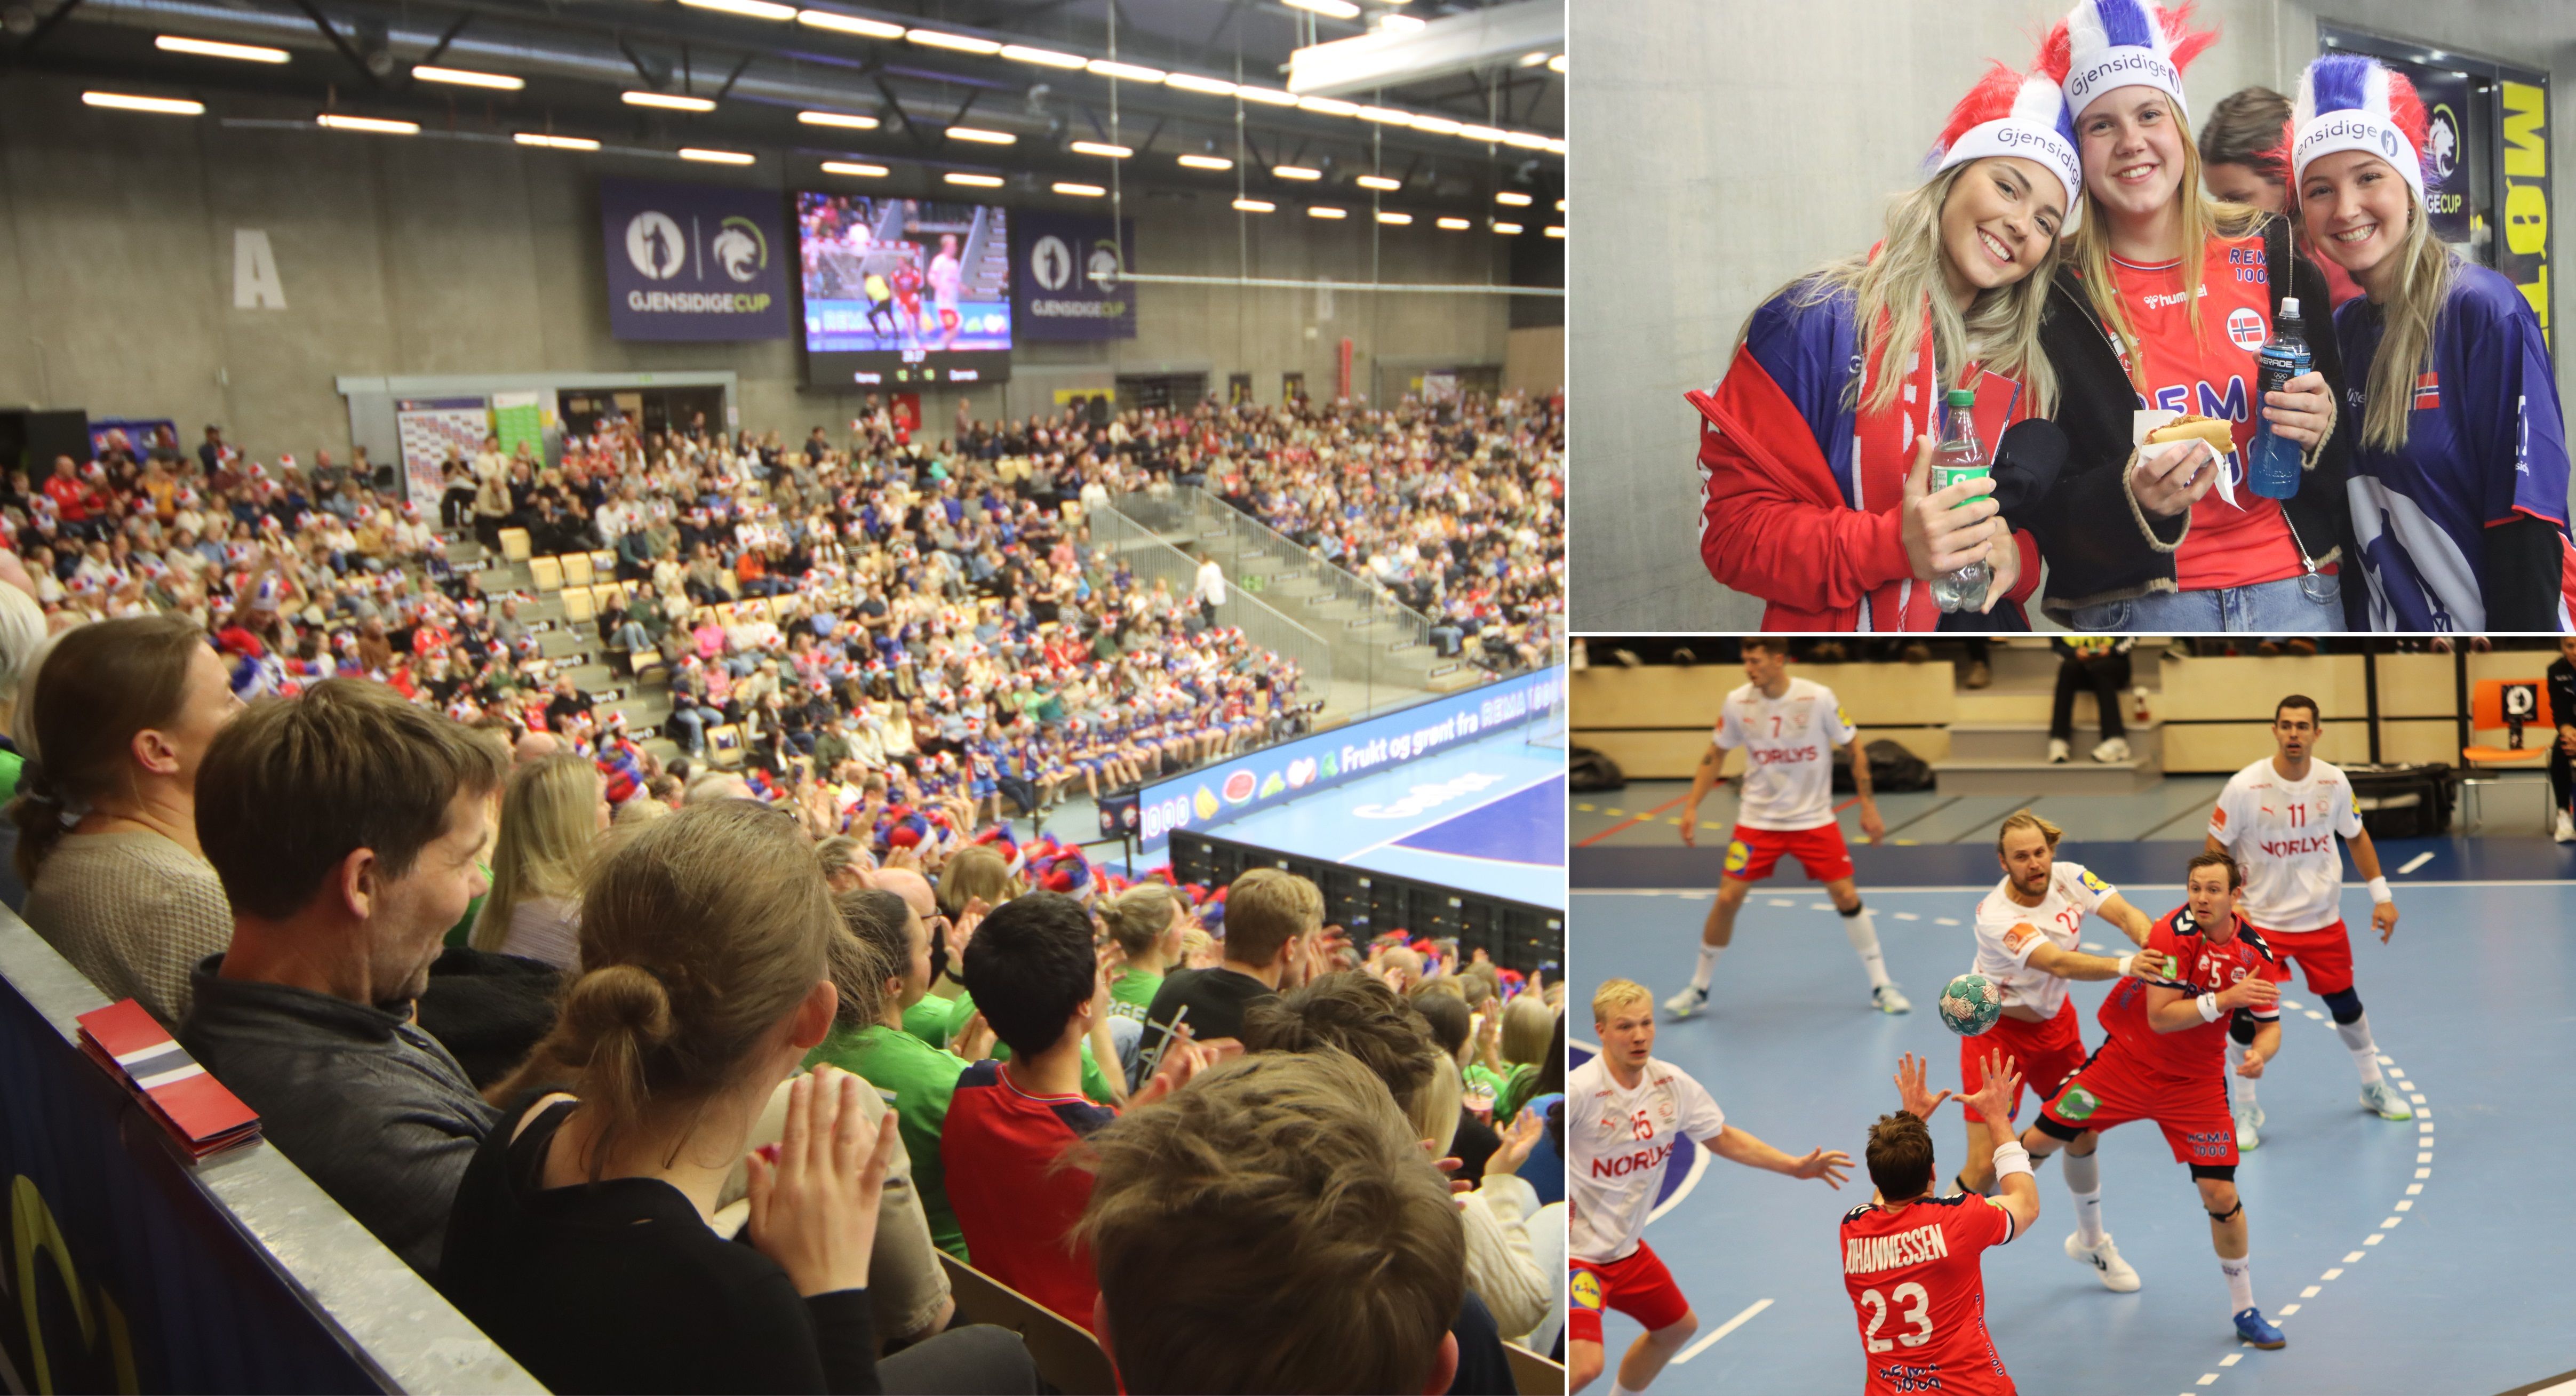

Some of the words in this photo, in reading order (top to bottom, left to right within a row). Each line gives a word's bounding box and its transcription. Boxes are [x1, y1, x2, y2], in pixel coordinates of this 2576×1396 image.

[2071, 54, 2167, 97] Gjensidige
[1998, 128, 2080, 193] Gjensidige
[233, 228, 288, 308] A
[2229, 248, 2267, 266] REM
[2236, 268, 2270, 286] 100
[2159, 283, 2208, 307] humel
[2260, 356, 2293, 368] WERADE
[1342, 738, 1388, 773] Frukt
[1390, 733, 1411, 760] og
[1413, 715, 1455, 756] grønt
[1456, 709, 1479, 737] fra
[1480, 692, 1526, 728] REMA
[1770, 716, 1781, 738] 7
[2287, 803, 2305, 828] 11
[2208, 961, 2222, 988] 5
[1630, 1110, 1653, 1141] 15
[1860, 1281, 1934, 1354] 23
